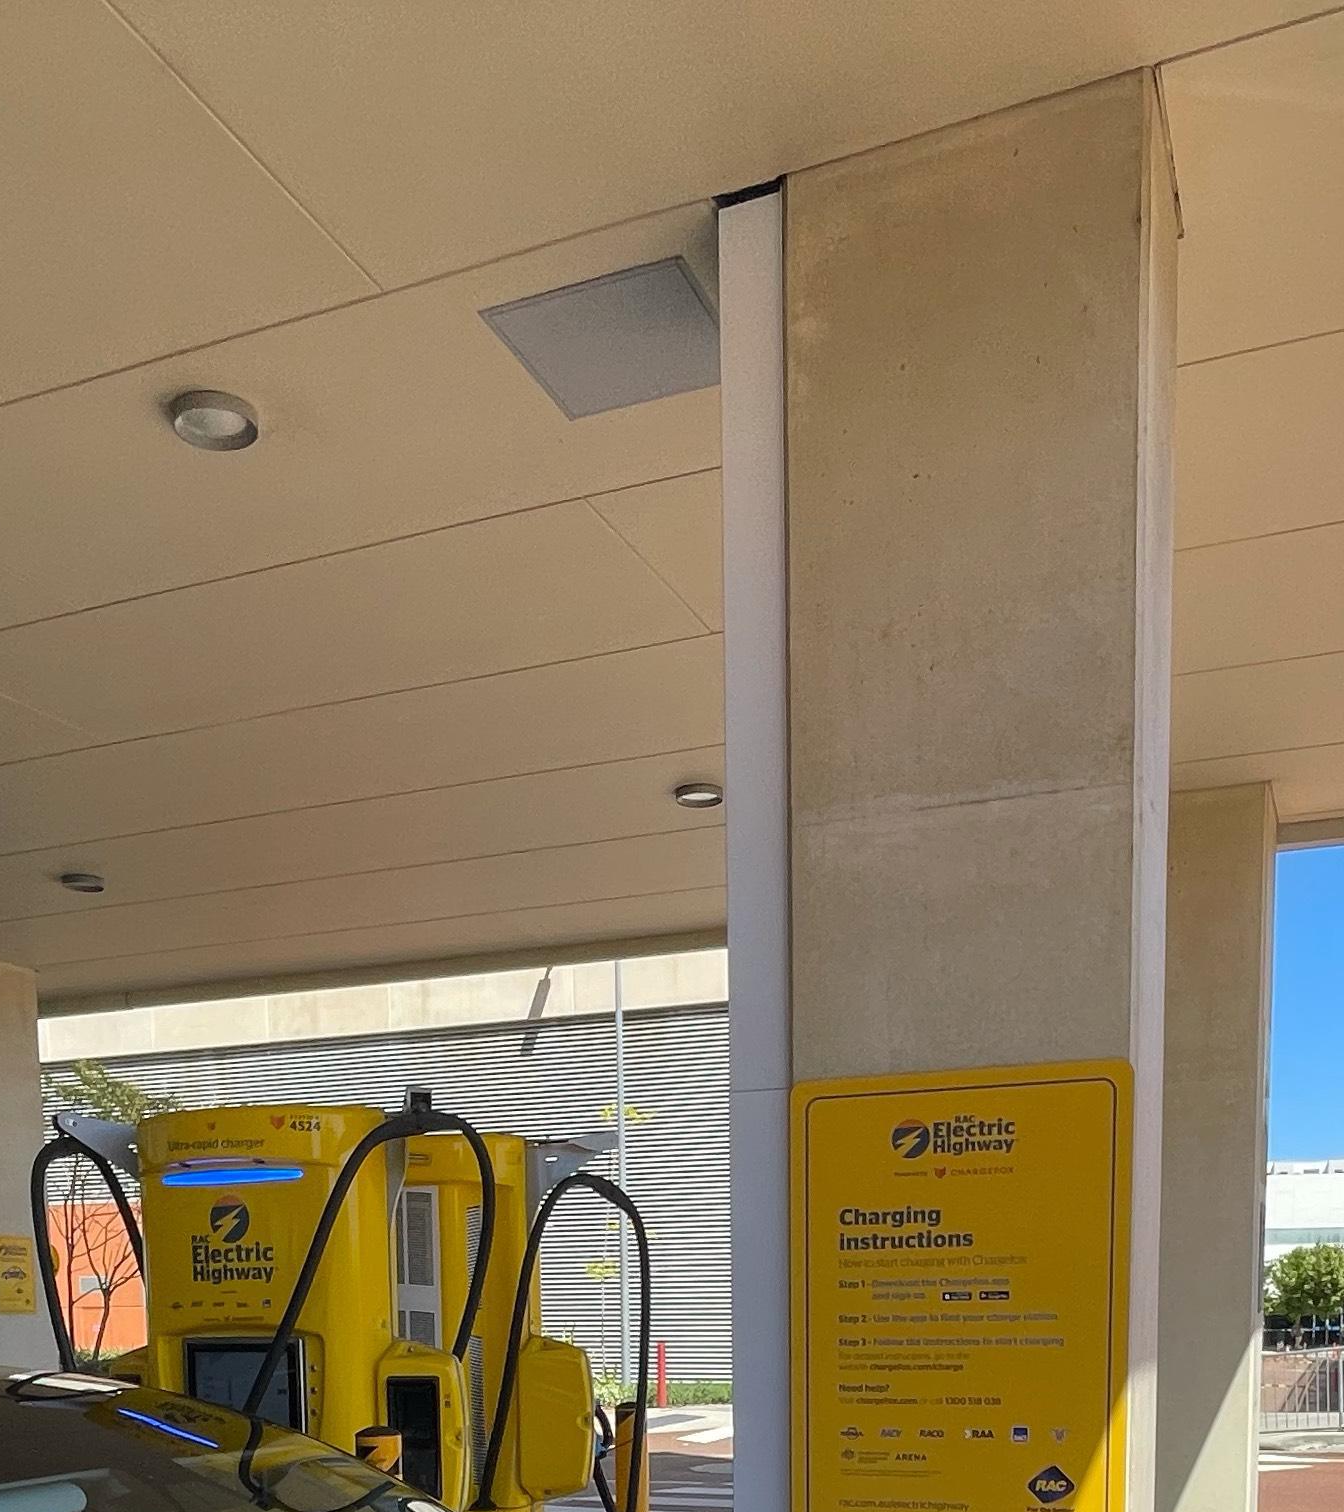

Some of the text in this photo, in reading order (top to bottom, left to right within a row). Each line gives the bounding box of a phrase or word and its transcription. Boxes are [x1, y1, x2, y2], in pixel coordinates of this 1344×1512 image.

[954, 1114, 976, 1123] RAC
[932, 1117, 1016, 1139] Electric
[220, 1137, 264, 1149] charger
[932, 1138, 1015, 1156] Highway
[839, 1205, 942, 1228] Charging
[191, 1234, 210, 1244] RAC
[191, 1240, 274, 1264] Electric
[192, 1264, 274, 1285] Highway
[1034, 1479, 1068, 1493] RAC
